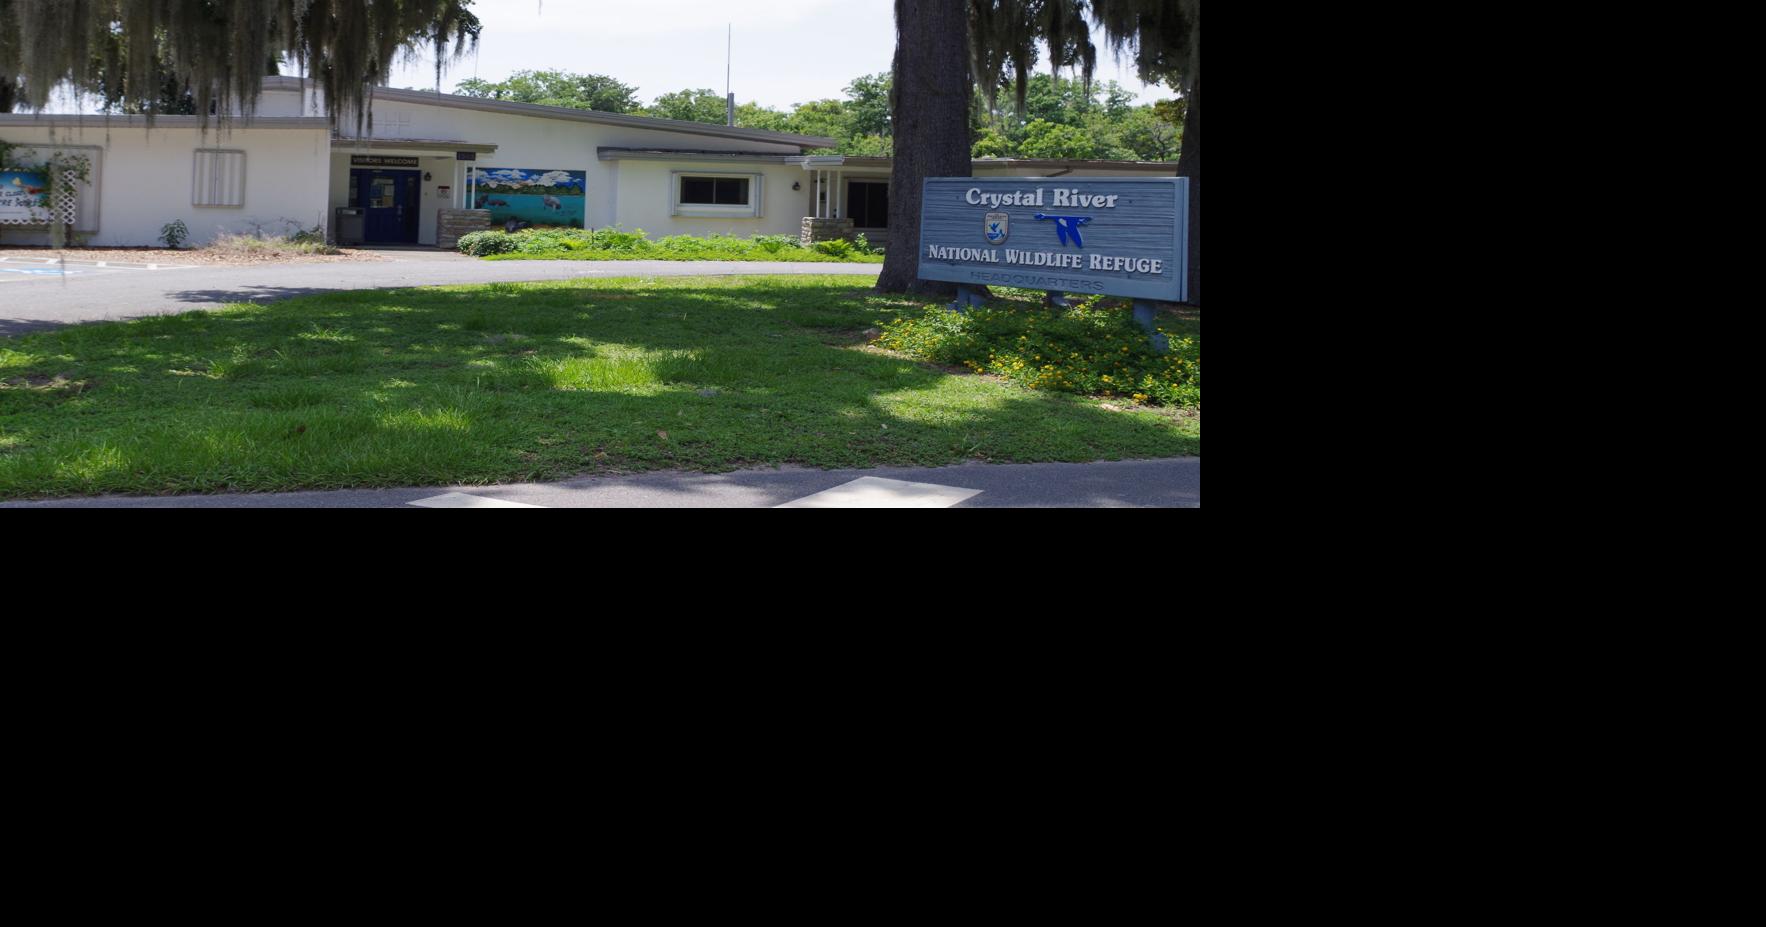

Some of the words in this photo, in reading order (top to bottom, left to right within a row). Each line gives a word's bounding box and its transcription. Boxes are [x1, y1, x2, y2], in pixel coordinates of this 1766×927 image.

[965, 187, 1044, 209] Crystal
[1053, 188, 1119, 208] River
[928, 244, 1000, 263] NATIONAL
[1005, 249, 1083, 268] WILDLIFE
[1089, 254, 1163, 274] REFUGE
[970, 271, 1104, 291] HEADQUARTERS
